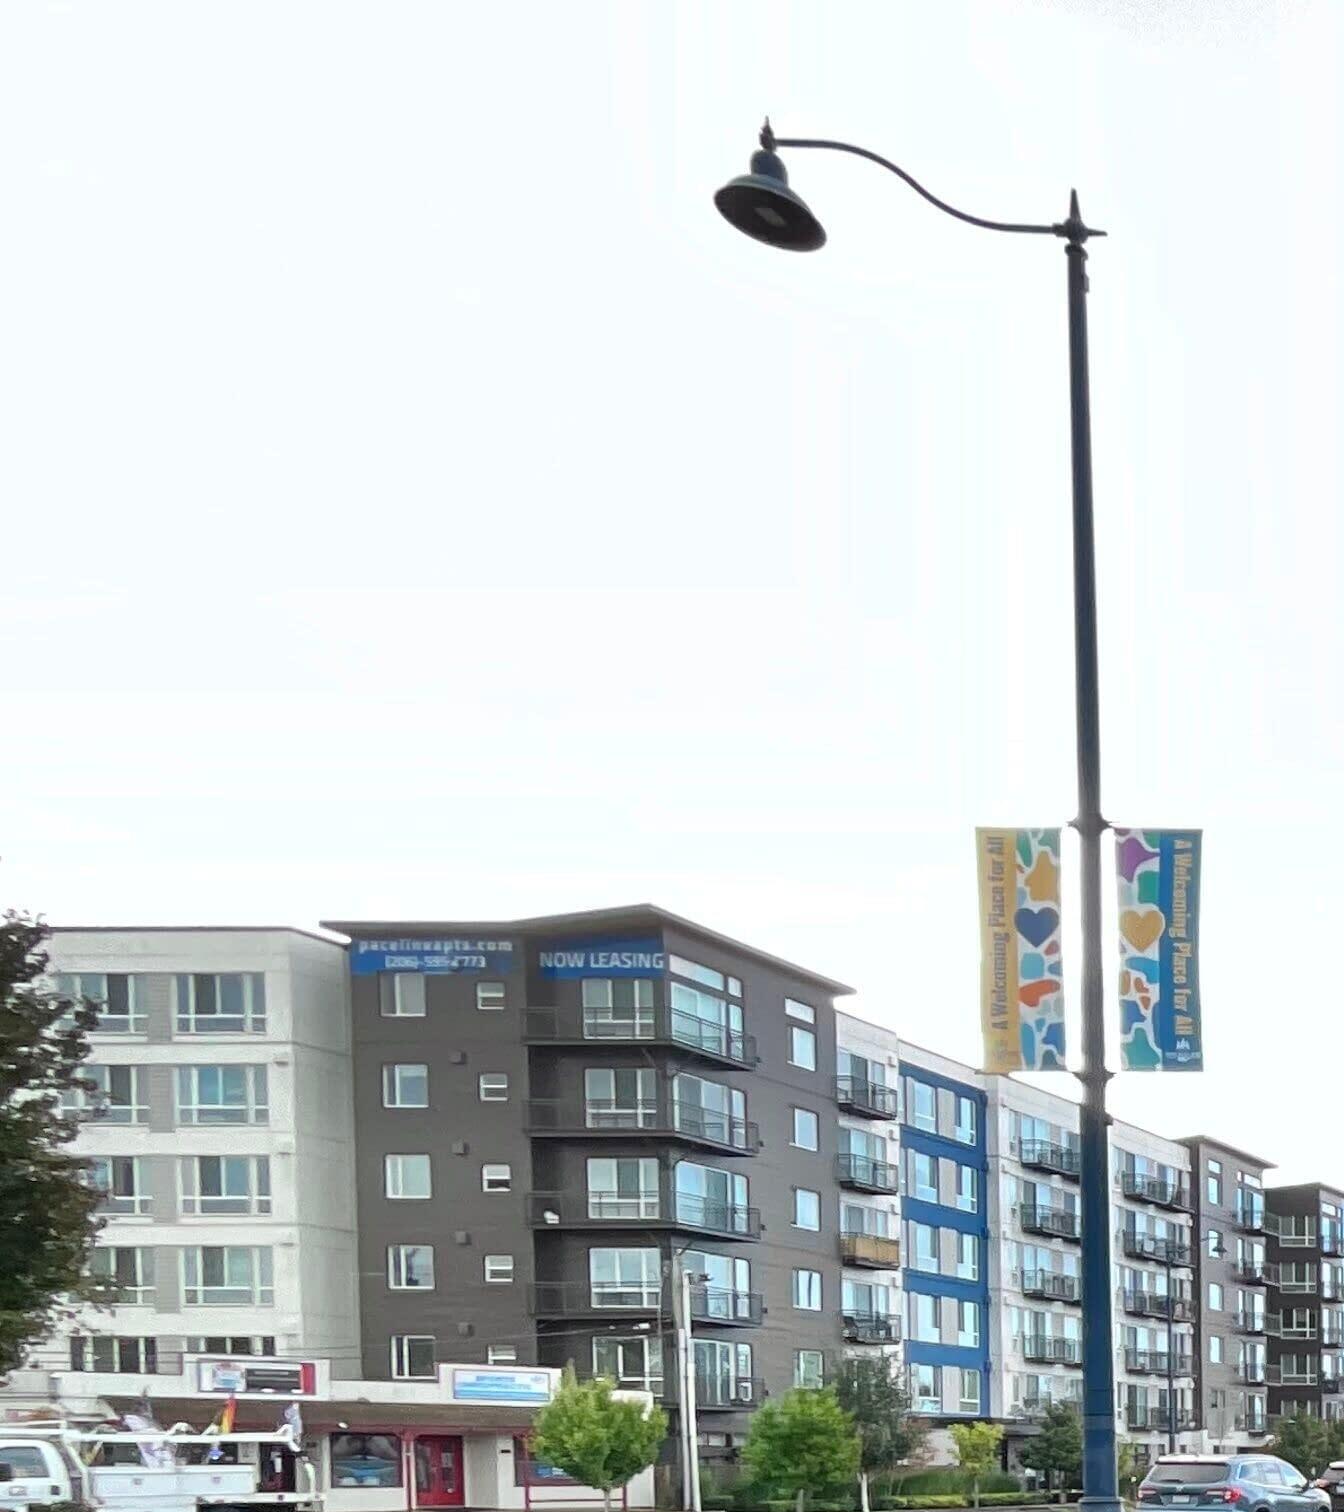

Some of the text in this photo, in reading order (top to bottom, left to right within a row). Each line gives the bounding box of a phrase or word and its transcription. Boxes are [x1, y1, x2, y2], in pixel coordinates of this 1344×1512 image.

[1174, 839, 1192, 850] A
[1169, 853, 1193, 938] Welcoming
[986, 836, 1010, 1030] A Welcoming Place for All
[539, 952, 665, 968] NOW LEASING
[1173, 942, 1193, 984] Place
[1174, 988, 1192, 1012] for
[1174, 1015, 1194, 1035] All
